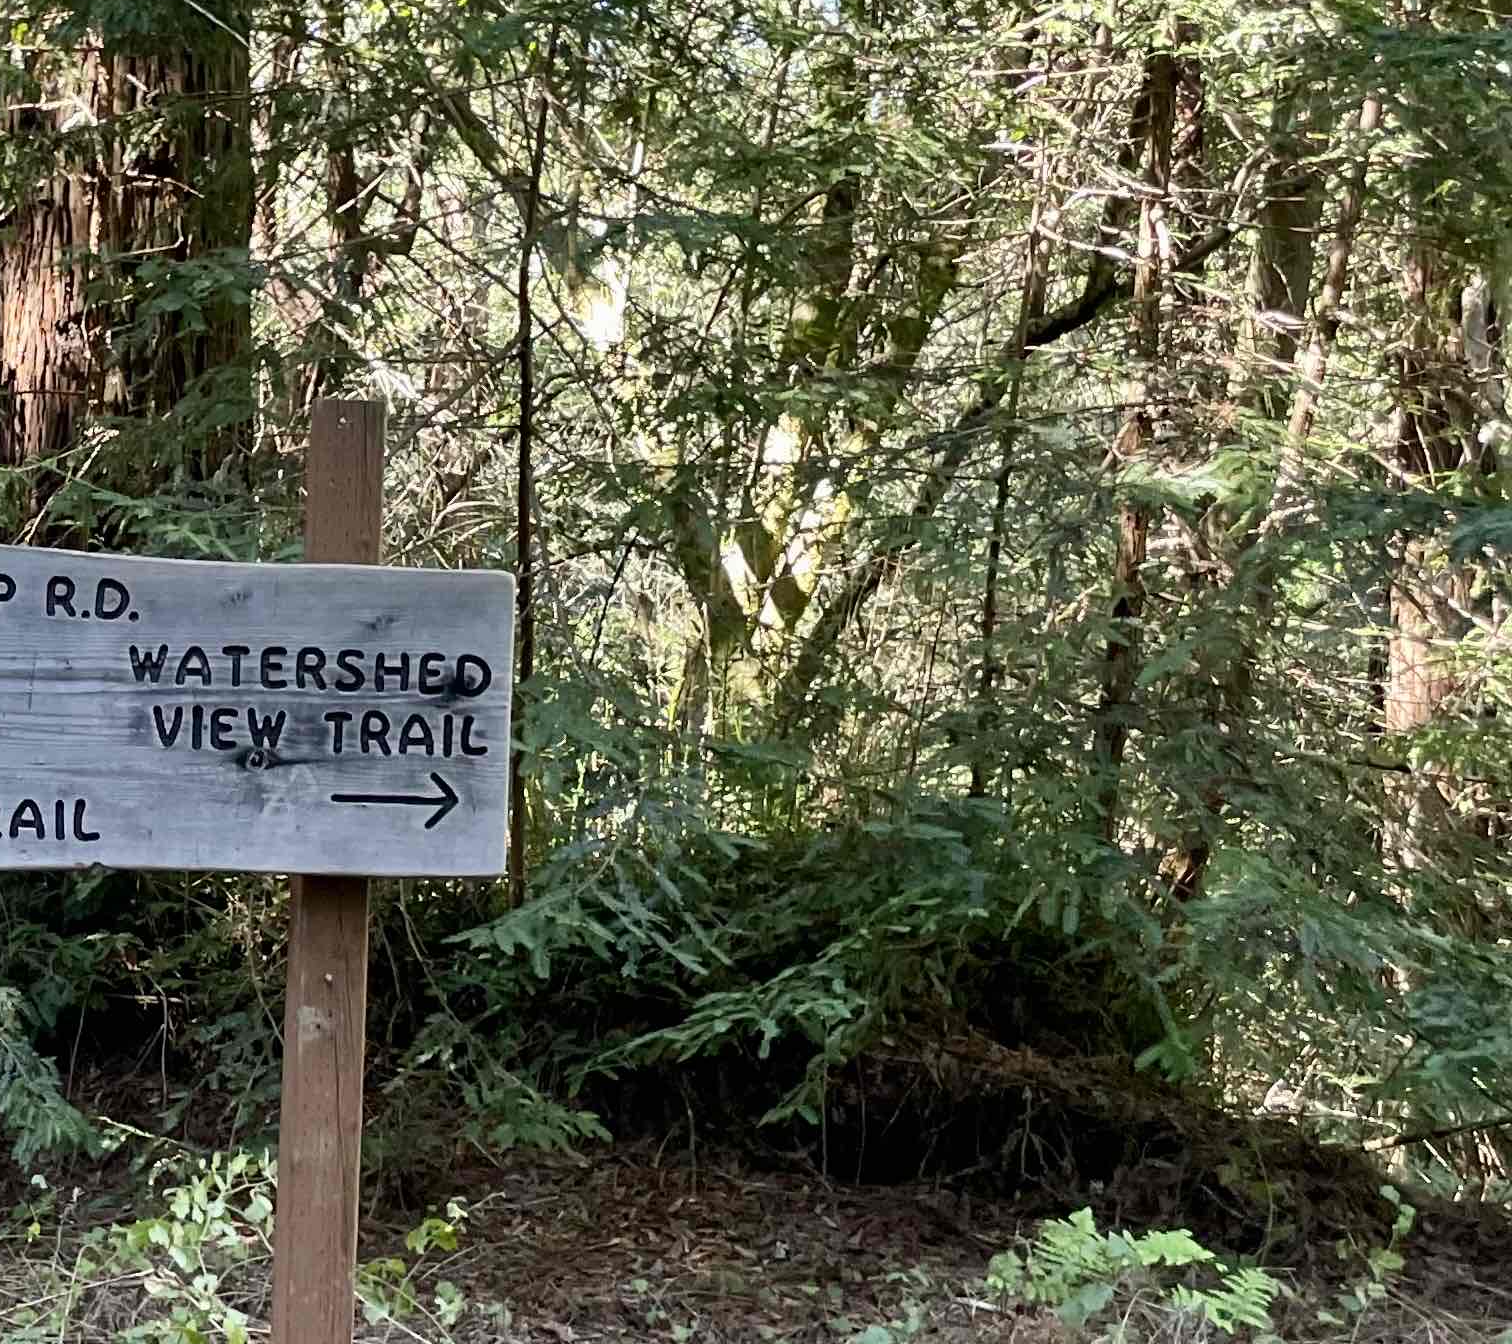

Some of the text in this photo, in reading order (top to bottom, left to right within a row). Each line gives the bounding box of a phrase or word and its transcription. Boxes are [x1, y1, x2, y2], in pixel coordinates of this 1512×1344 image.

[46, 575, 140, 622] R.D.
[129, 643, 492, 698] WATERSHED
[153, 704, 488, 757] VIEW TRAIL
